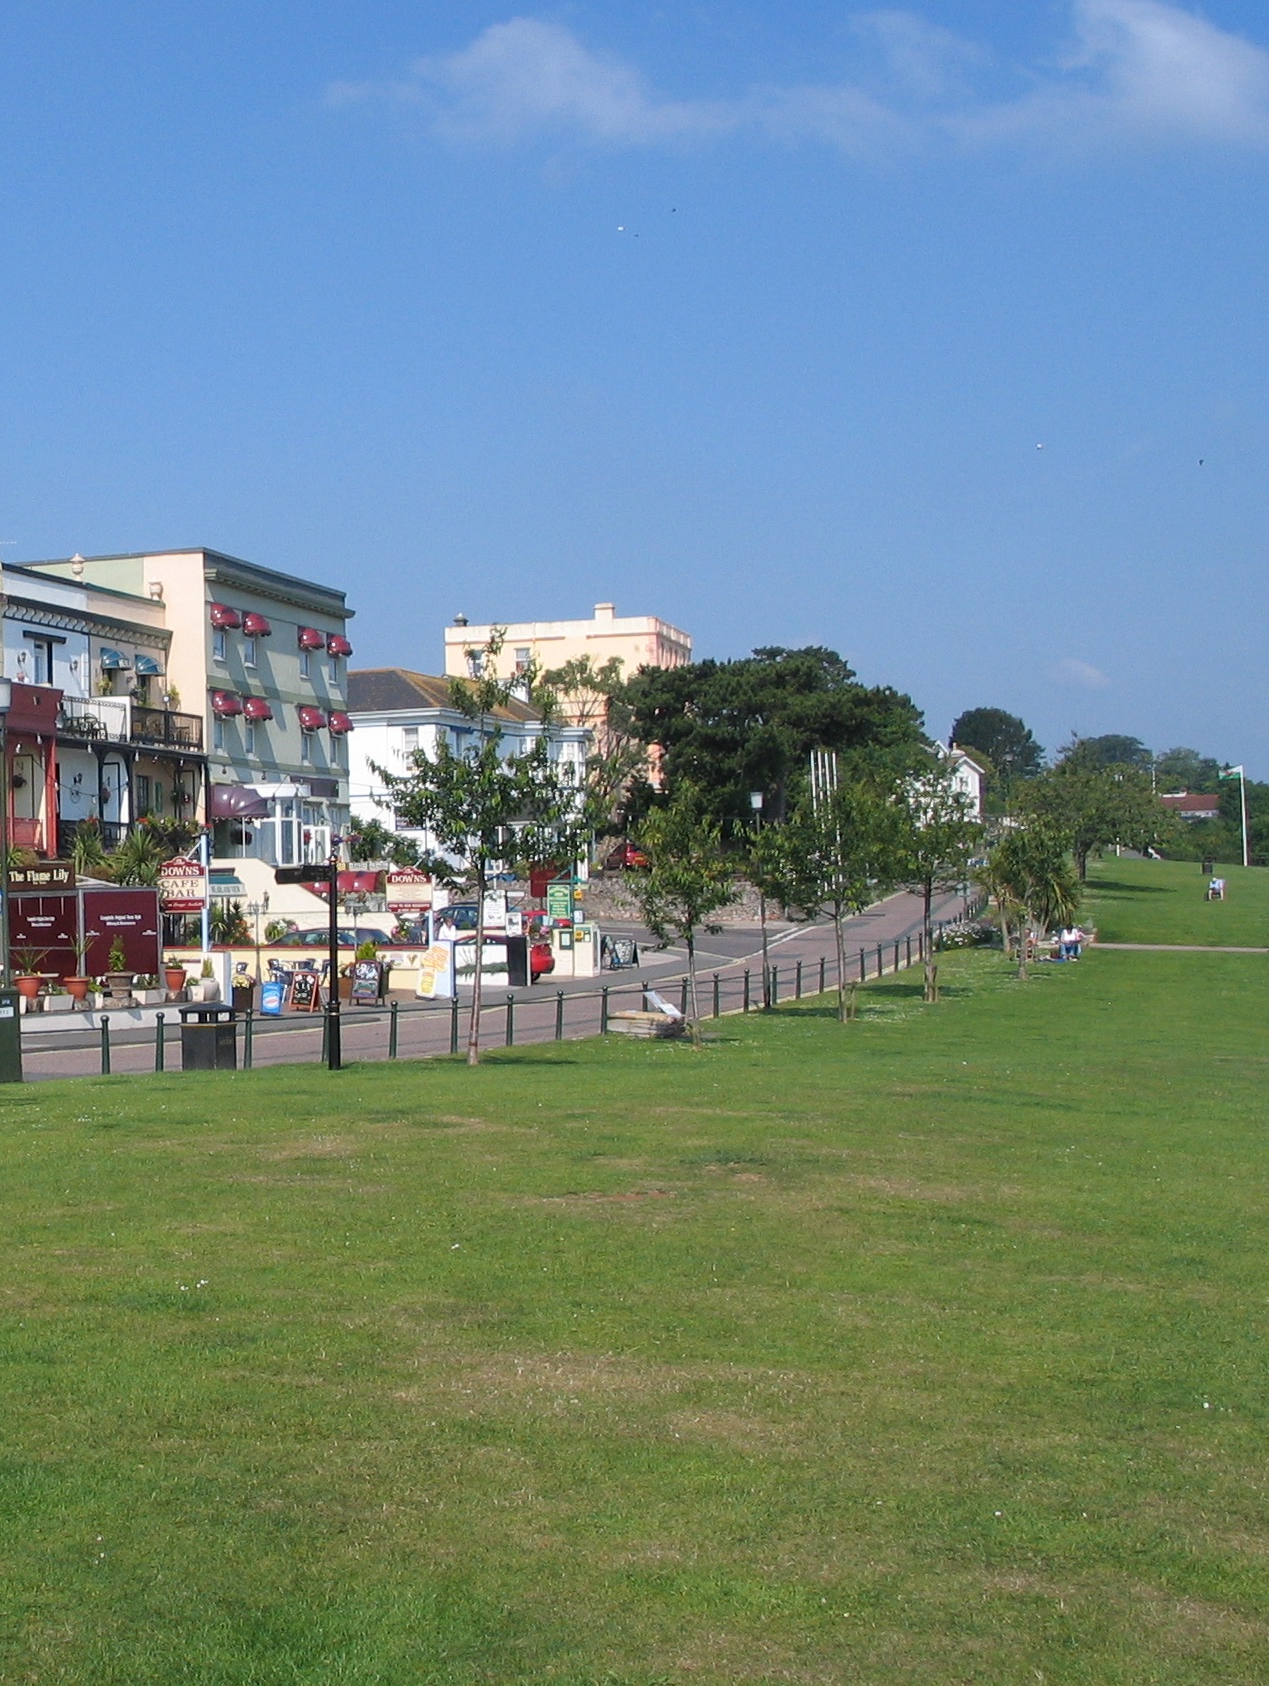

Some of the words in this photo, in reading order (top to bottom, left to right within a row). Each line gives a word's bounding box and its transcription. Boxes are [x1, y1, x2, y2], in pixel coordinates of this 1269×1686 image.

[161, 865, 199, 876] DOWNS
[9, 871, 24, 882] The
[26, 870, 50, 882] Flame
[53, 868, 69, 883] Lily
[391, 875, 427, 883] DOWNS
[162, 880, 199, 888] CAFE
[167, 889, 195, 898] BAR
